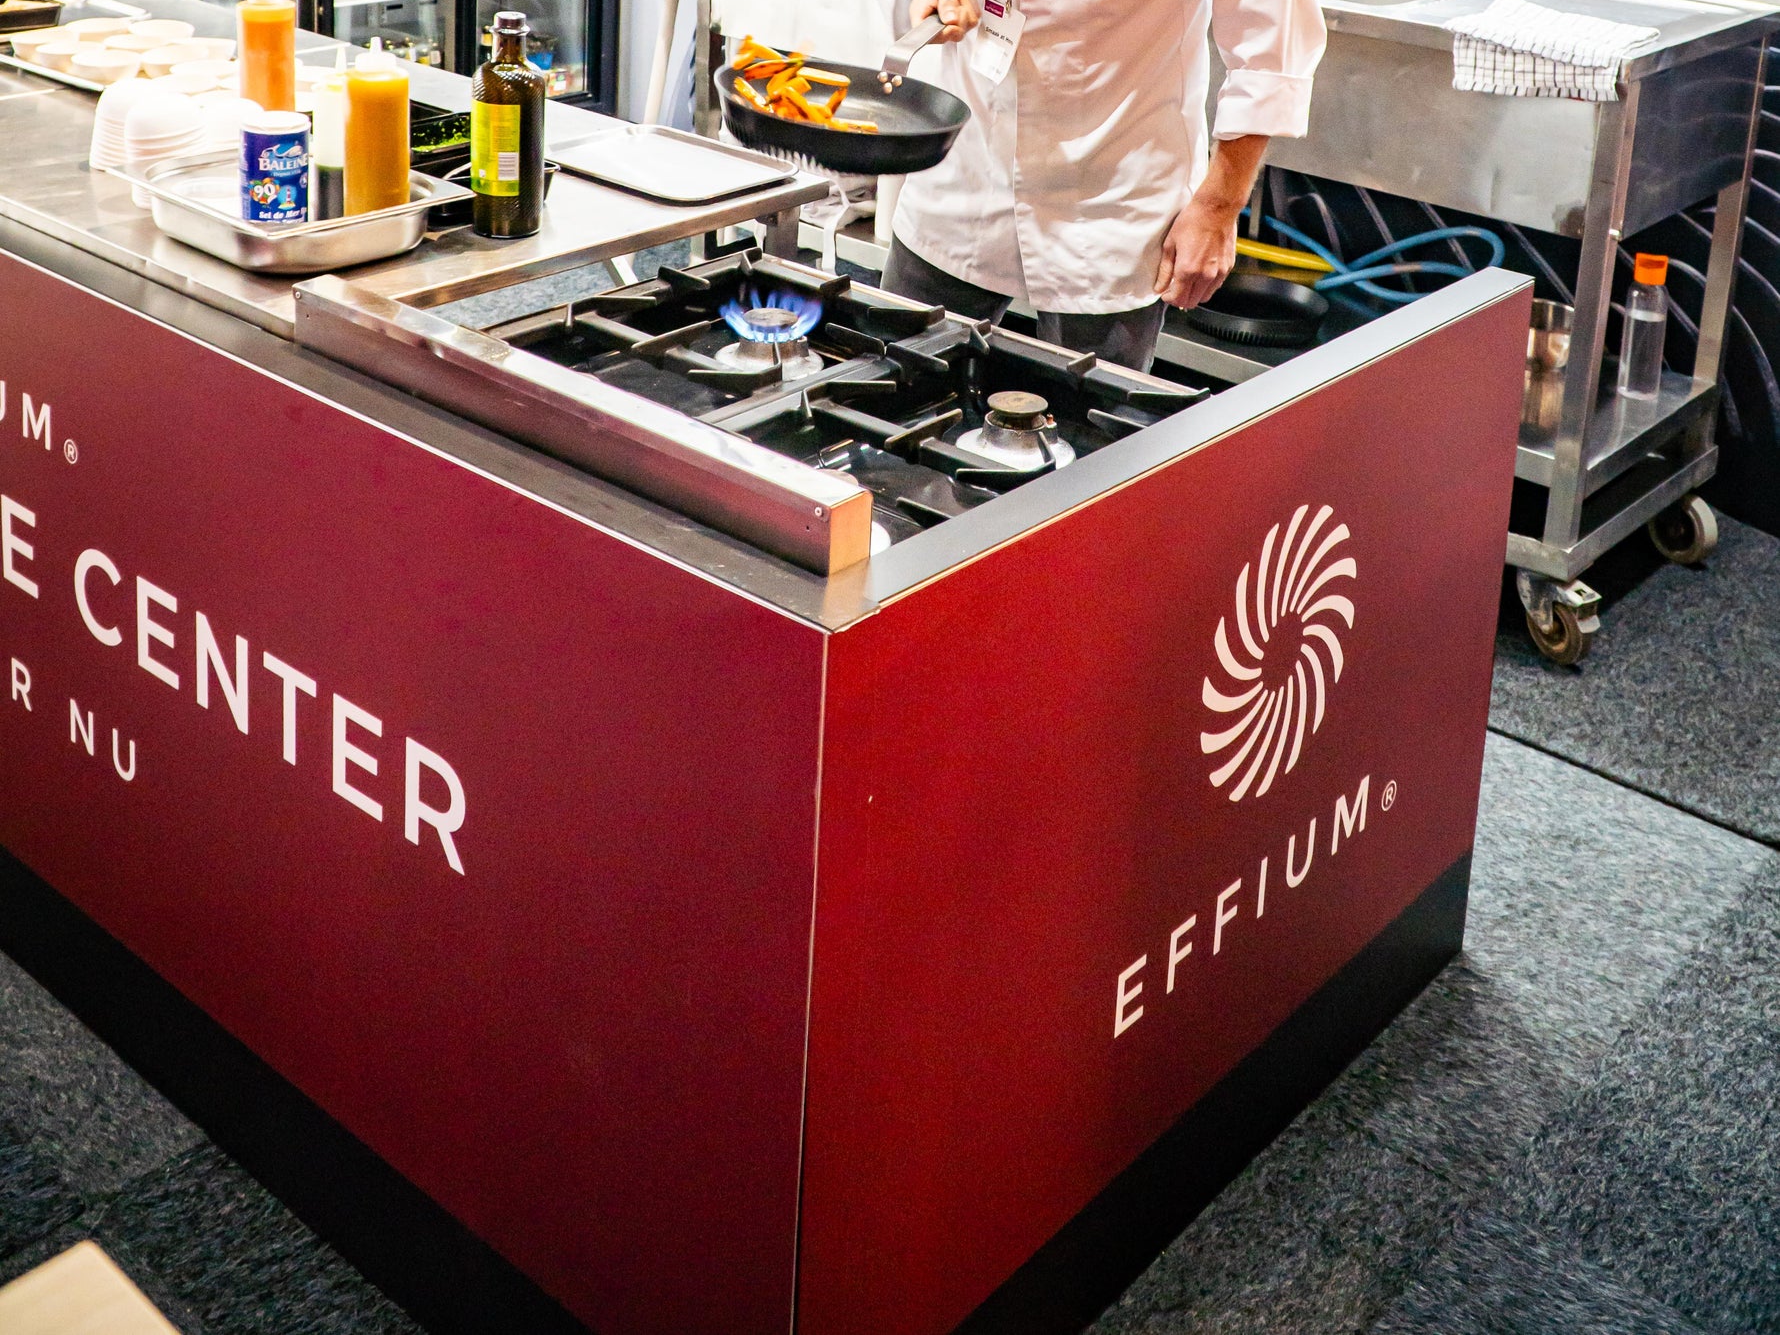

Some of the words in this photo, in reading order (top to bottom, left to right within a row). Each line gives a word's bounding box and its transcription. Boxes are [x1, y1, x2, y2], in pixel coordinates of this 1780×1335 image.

[258, 152, 308, 171] BALEINE
[253, 184, 278, 205] 90
[74, 548, 465, 876] CENTER
